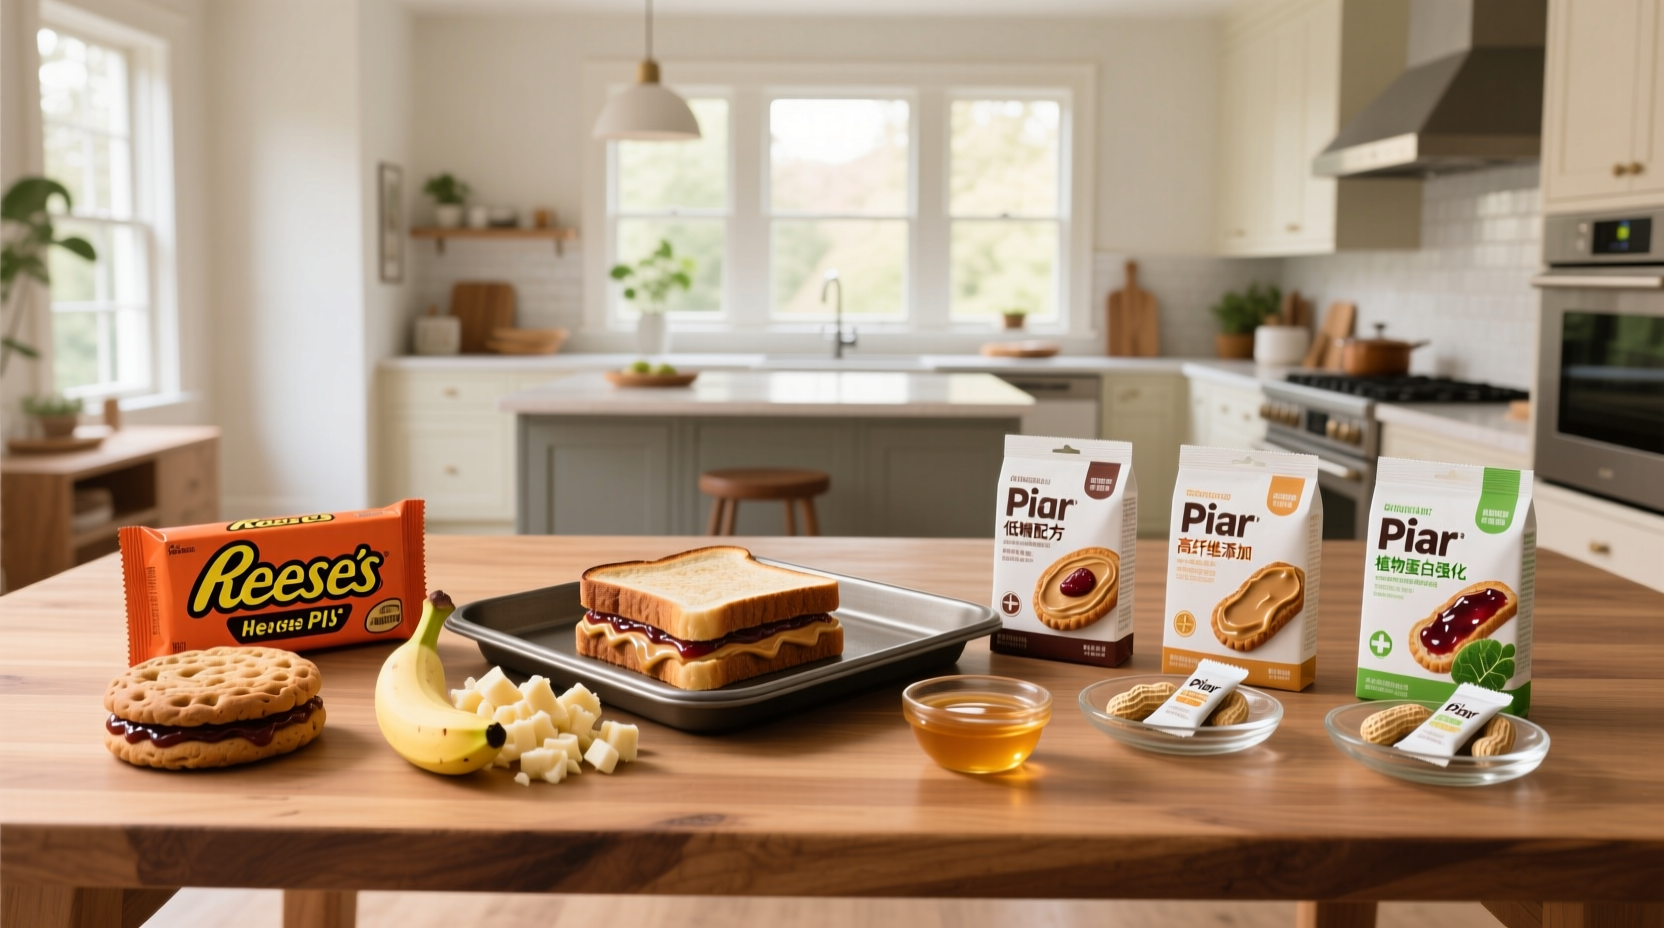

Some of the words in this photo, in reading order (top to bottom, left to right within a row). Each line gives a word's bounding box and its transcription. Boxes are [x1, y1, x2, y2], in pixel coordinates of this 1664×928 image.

[1006, 487, 1075, 521] Piar
[1181, 502, 1255, 538] Piar
[1378, 517, 1459, 557] Piar
[192, 543, 381, 613] Reese's
